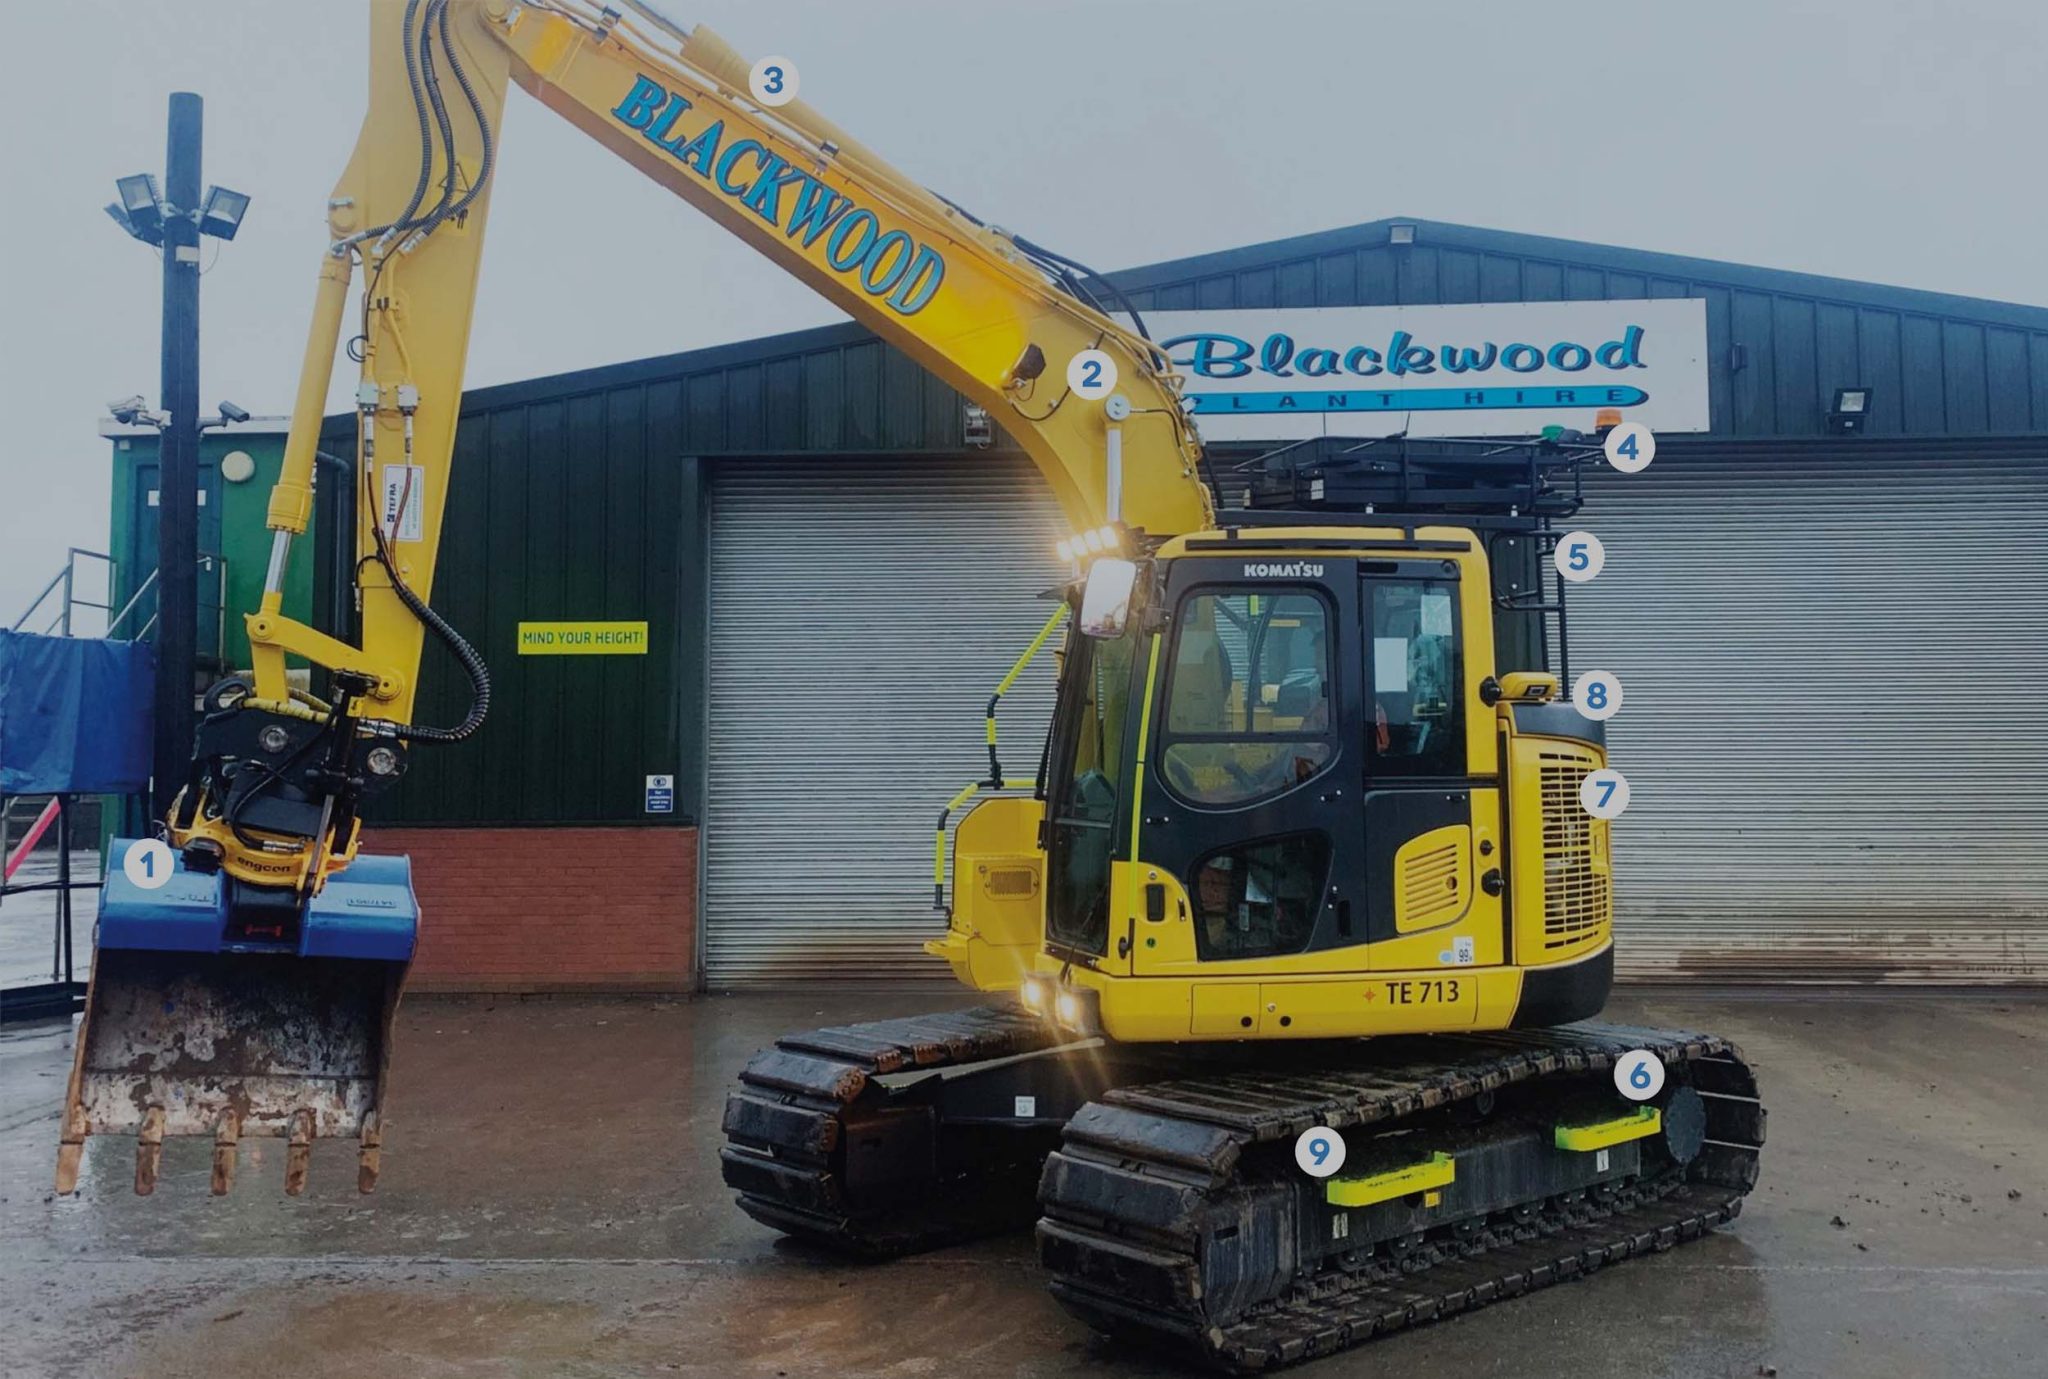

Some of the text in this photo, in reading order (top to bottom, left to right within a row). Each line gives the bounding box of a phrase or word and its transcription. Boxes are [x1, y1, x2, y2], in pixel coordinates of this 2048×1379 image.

[611, 73, 945, 316] BLACKWOOD
[1159, 325, 1648, 378] Blackwood
[1464, 389, 1625, 404] HIRE
[388, 483, 397, 512] TEFRA
[1244, 561, 1324, 578] KOMATSU
[523, 631, 643, 644] MIND YOUR HEIGHT!
[237, 856, 291, 872] engcon
[1386, 980, 1459, 1005] TE 713
